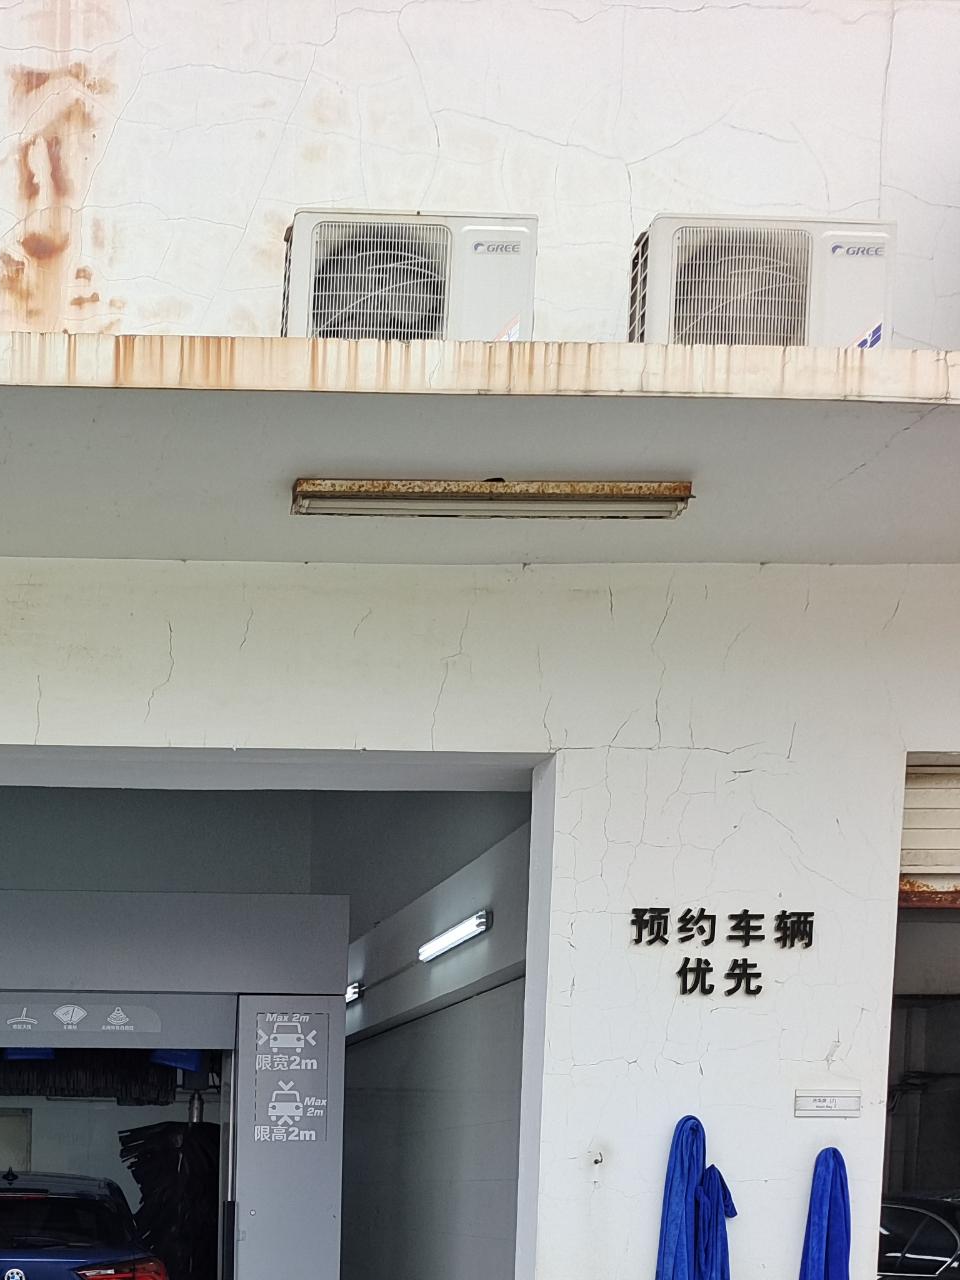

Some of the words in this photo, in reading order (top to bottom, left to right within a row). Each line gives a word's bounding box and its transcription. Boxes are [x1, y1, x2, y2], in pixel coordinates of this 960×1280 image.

[486, 244, 520, 253] GREE
[845, 246, 885, 256] GREE
[630, 907, 815, 949] 预约车辆
[676, 956, 763, 997] 优先
[265, 1013, 289, 1023] Max
[292, 1013, 310, 1023] 2m
[255, 1054, 318, 1071] 限宽2m
[303, 1097, 327, 1106] Max
[306, 1107, 324, 1117] 2m
[254, 1125, 316, 1142] 限高2m
